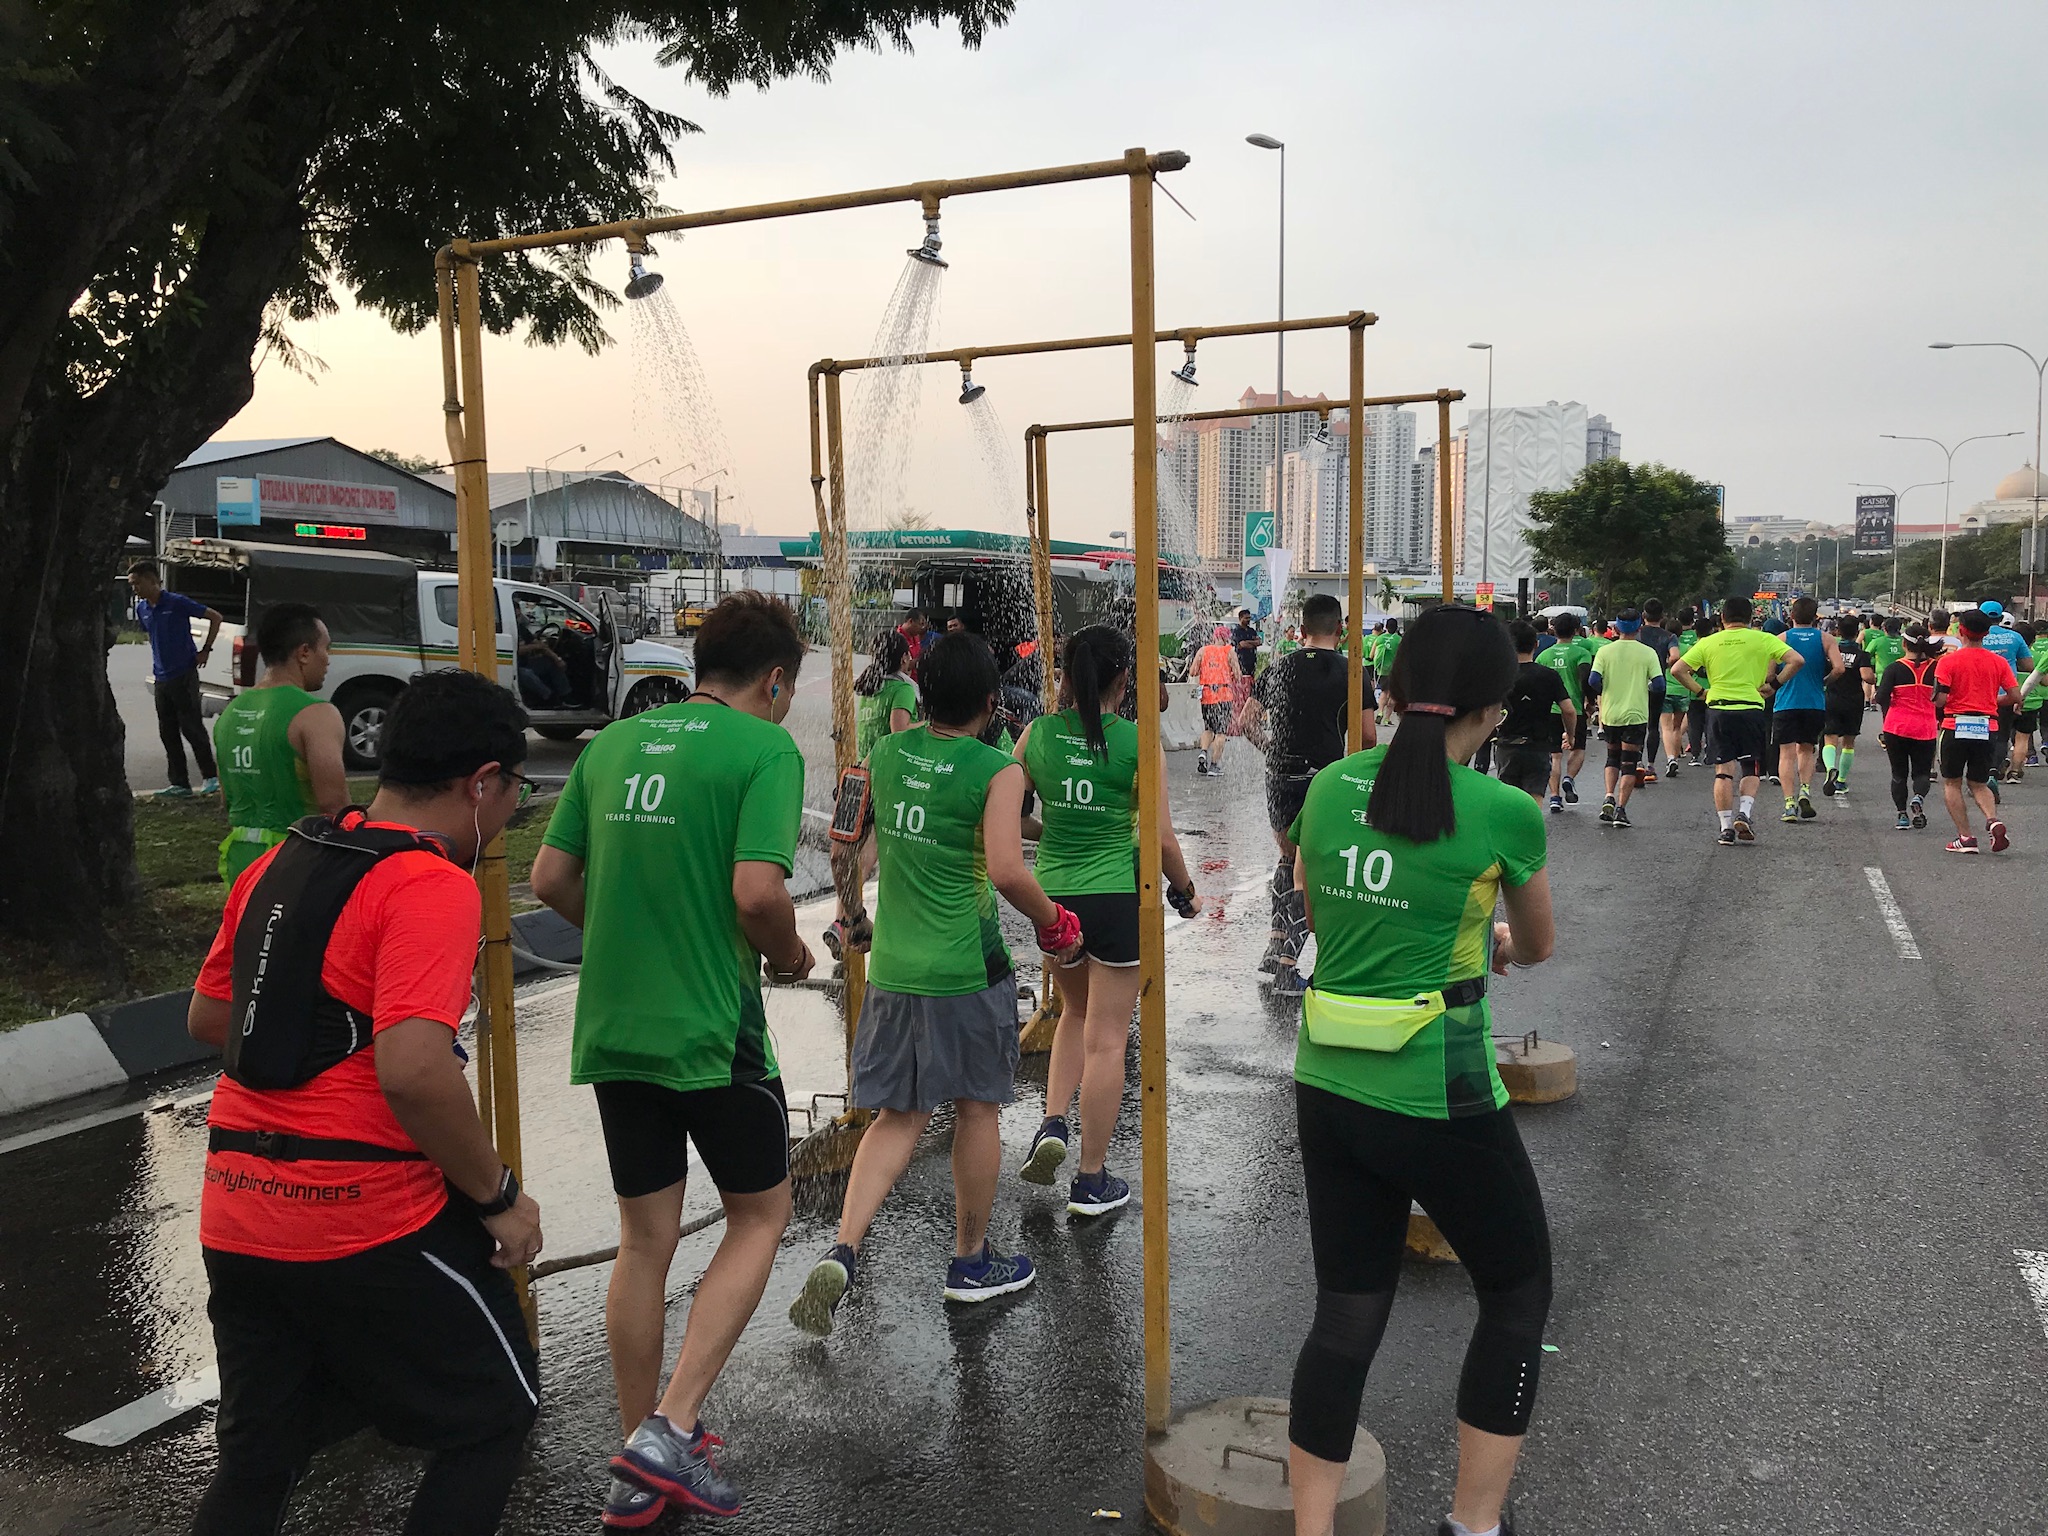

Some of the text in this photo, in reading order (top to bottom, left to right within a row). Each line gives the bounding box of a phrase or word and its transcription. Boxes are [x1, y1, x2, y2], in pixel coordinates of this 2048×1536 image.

[259, 479, 396, 511] UTUSAN MOTOR IMPORT SDN BHD
[1861, 497, 1890, 505] GATSBY
[900, 535, 952, 545] PETRONAS
[1553, 658, 1564, 667] 10
[232, 745, 252, 768] 10
[1340, 773, 1370, 785] Standard
[1356, 784, 1367, 792] KL
[624, 773, 666, 812] 10
[1061, 777, 1094, 804] 10
[1051, 801, 1106, 812] YEARS RUNNING
[605, 813, 676, 825] YEARS RUNNING
[893, 801, 925, 834] 10
[881, 826, 938, 845] YEARS RUNNING
[1339, 844, 1393, 892] 10
[1320, 884, 1410, 910] YEARS RUNNING
